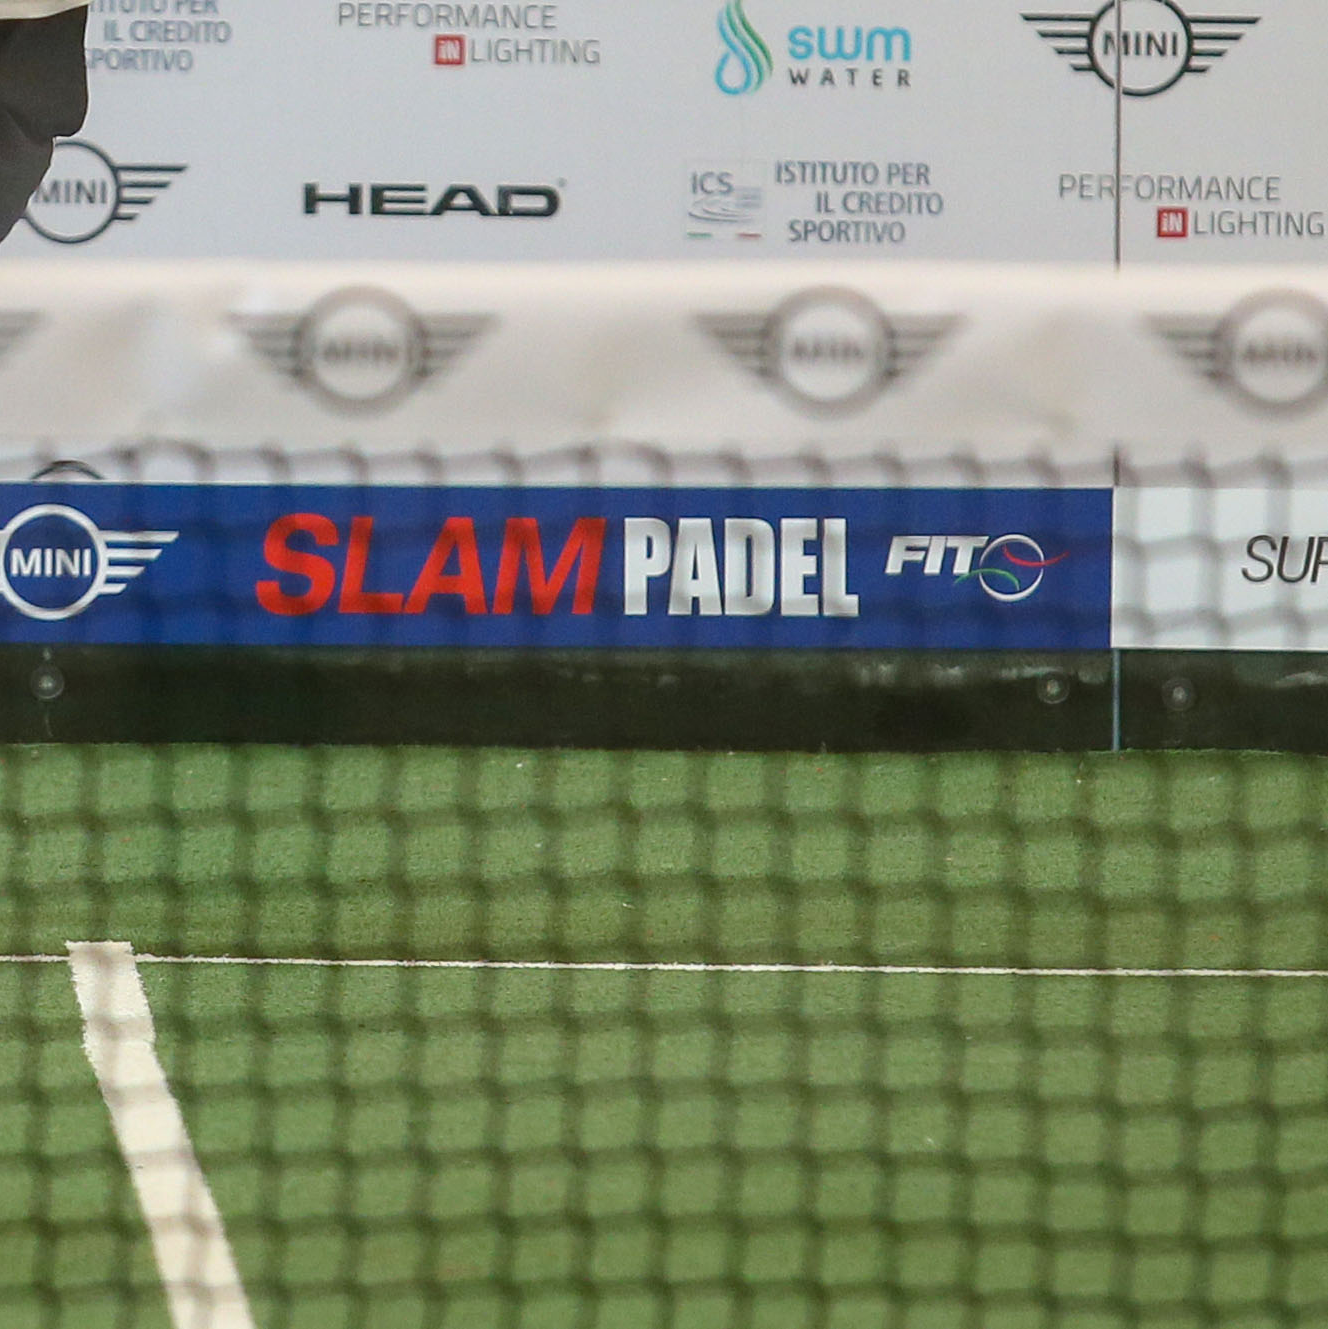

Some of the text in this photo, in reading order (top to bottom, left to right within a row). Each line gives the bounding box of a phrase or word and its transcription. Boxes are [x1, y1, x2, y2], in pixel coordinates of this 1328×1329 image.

[338, 2, 556, 29] PERFORMANCE
[104, 20, 232, 43] IL CREDITO
[1102, 30, 1179, 58] MINI
[88, 48, 193, 71] PORTIVO
[470, 39, 601, 65] LIGHTING
[788, 68, 912, 87] WATER
[691, 173, 733, 195] ICS
[775, 162, 931, 185] ISTITUTO PER
[1059, 174, 1281, 200] PERFORMANCE
[303, 183, 560, 218] HEAD
[815, 191, 943, 215] IL CREDITO
[788, 220, 906, 244] SPORTIVO
[1193, 211, 1325, 238] LIGHTING
[11, 547, 92, 577] MINI
[254, 512, 990, 618] SLAM PADEL FIT
